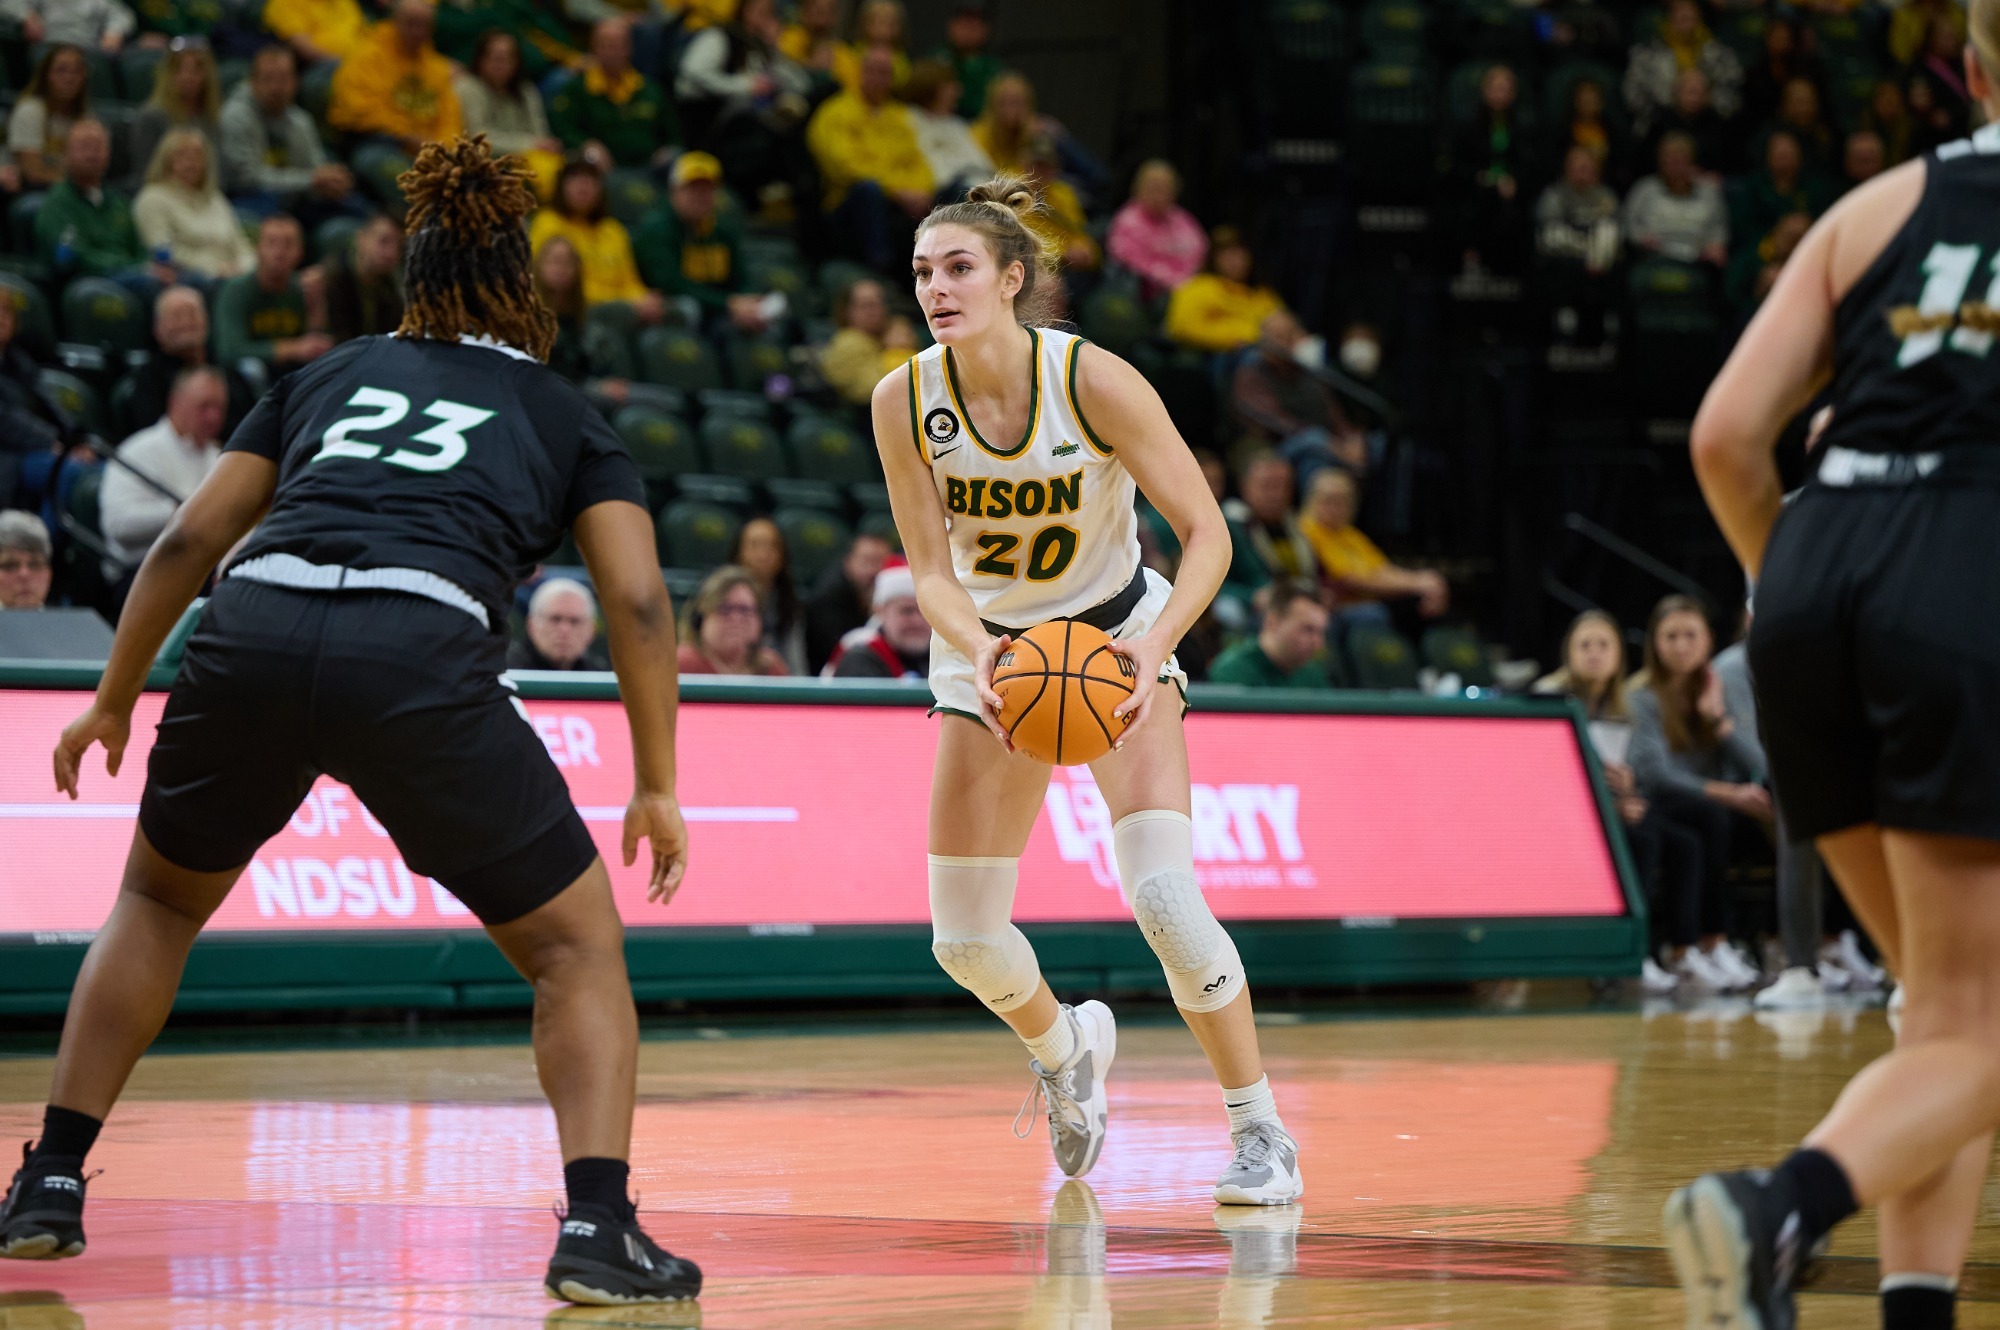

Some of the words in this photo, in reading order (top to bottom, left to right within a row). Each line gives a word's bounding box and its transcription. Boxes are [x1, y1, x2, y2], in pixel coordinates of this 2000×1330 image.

[311, 386, 498, 472] 23
[945, 466, 1084, 520] BISON
[972, 522, 1081, 583] 20
[290, 786, 350, 837] OF
[250, 857, 417, 919] NDSU
